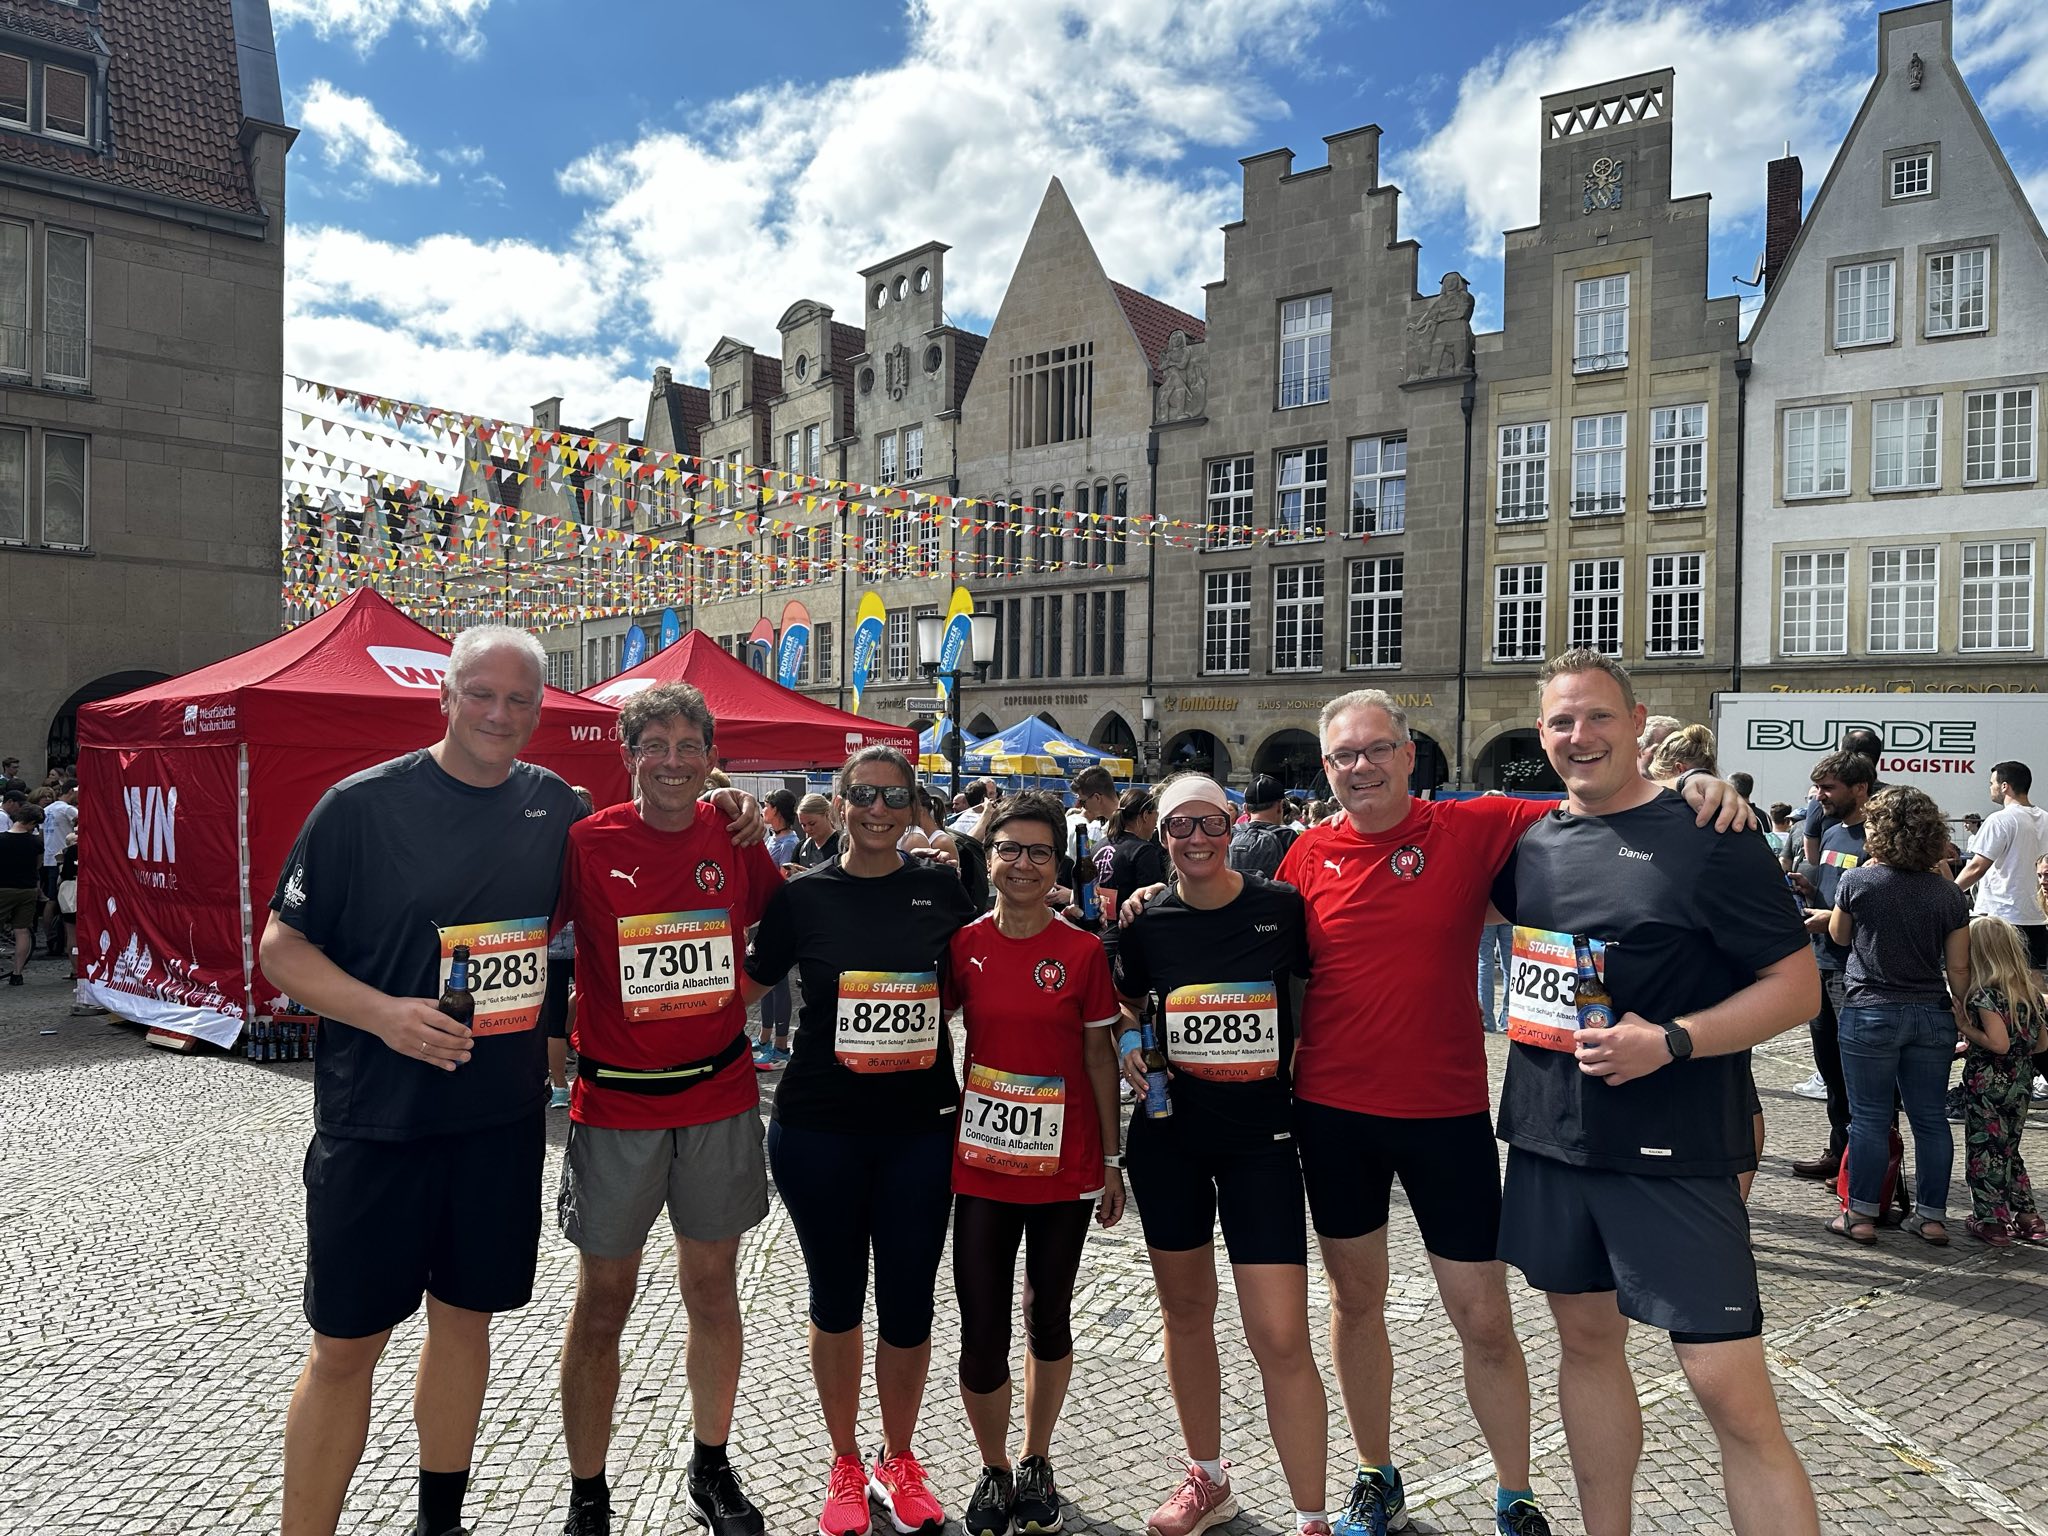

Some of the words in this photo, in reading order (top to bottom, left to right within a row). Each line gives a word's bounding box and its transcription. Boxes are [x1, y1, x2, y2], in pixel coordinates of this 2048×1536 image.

[940, 624, 959, 671] ERDINGER
[779, 635, 795, 677] ERDINGER
[910, 701, 944, 709] Salzstraße
[1004, 695, 1053, 706] COPENHAGEN
[1055, 694, 1088, 705] STUDIOS
[1179, 696, 1239, 712] Tollkötter
[570, 719, 619, 742] wn.d
[1880, 758, 1976, 774] LOGISTIK
[525, 809, 547, 818] Guido
[124, 786, 178, 864] WN
[1401, 855, 1414, 866] SV
[1618, 846, 1654, 861] Daniel
[705, 871, 716, 881] SV
[911, 898, 932, 906] Anne
[623, 927, 653, 938] 08.09.
[655, 922, 702, 935] STAFFEL
[704, 920, 726, 931] 2024
[1254, 922, 1278, 932] Vroni
[447, 937, 477, 950] 0809.
[478, 931, 526, 946] STAFFEL
[1528, 940, 1570, 959] STAFFEL
[624, 965, 635, 980] D
[637, 941, 713, 979] 7301
[721, 955, 731, 969] 4
[540, 966, 546, 982] 3
[1044, 968, 1057, 979] SV
[628, 981, 680, 995] Concordia
[682, 976, 729, 989] Albachten
[843, 982, 870, 992] 08.09.
[872, 983, 918, 993] STAFFEL
[919, 983, 937, 992] 2024
[1515, 962, 1579, 1007] 8283
[1170, 996, 1197, 1006] 08.09.
[1199, 993, 1247, 1004] STAFFEL
[1248, 993, 1271, 1003] 2024
[840, 1017, 849, 1031] B
[852, 1003, 926, 1033] 8283
[928, 1016, 936, 1030] 2
[1556, 1012, 1579, 1021] Albach
[1170, 1031, 1180, 1043] B
[1183, 1013, 1262, 1044] 8283
[1265, 1027, 1274, 1041] 4
[993, 1081, 1036, 1097] STAFFEL
[1037, 1088, 1059, 1097] 2024
[965, 1109, 974, 1123] D
[977, 1097, 1043, 1136] 7301
[1049, 1123, 1058, 1137] 3
[965, 1128, 1006, 1147] Concordia
[1008, 1139, 1054, 1151] Albachten
